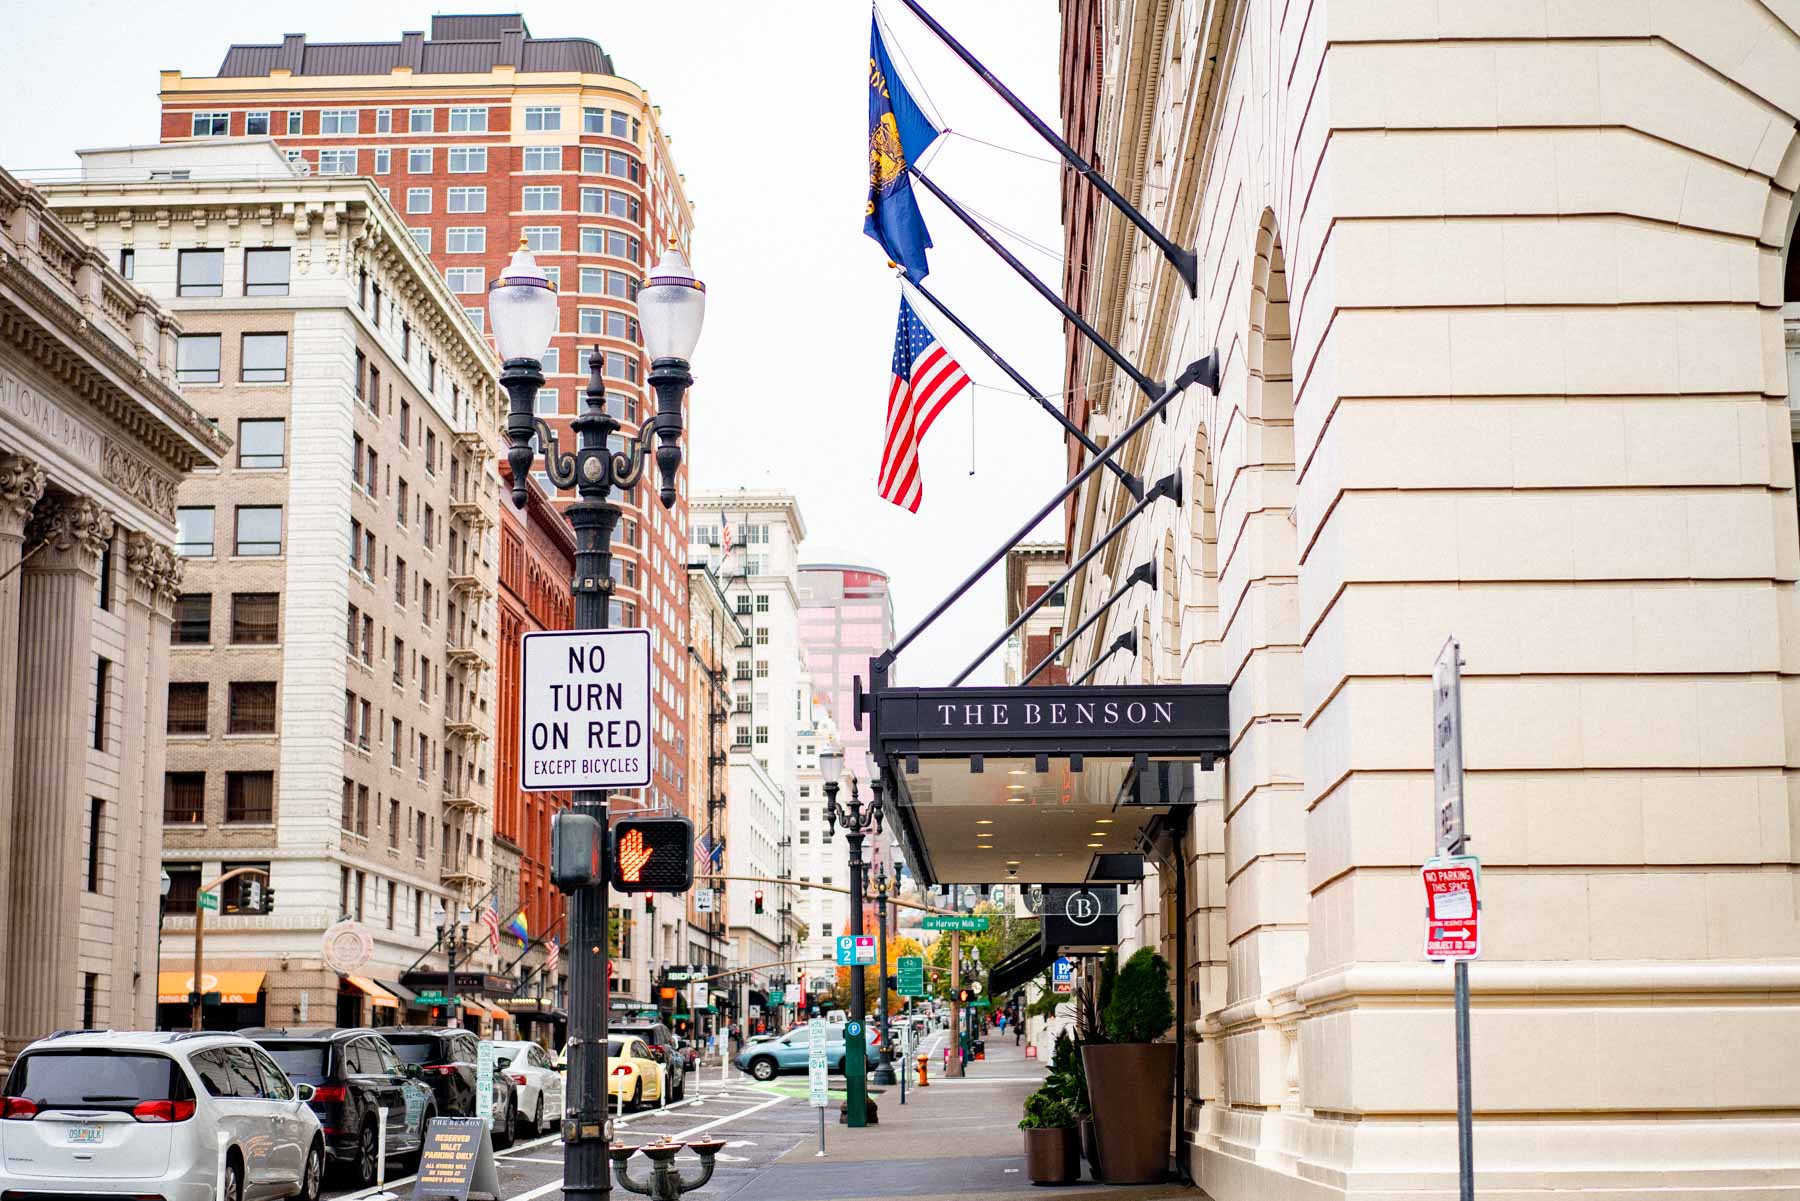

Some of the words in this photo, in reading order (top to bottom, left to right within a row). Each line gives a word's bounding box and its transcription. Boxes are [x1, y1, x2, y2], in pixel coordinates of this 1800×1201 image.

[64, 417, 95, 463] BANK
[568, 645, 605, 674] NO
[549, 683, 622, 712] TURN
[938, 703, 1009, 725] THE
[1023, 702, 1174, 725] BENSON
[532, 722, 569, 750] ON
[588, 720, 641, 749] RED
[534, 759, 576, 775] EXCEPT
[582, 758, 639, 774] BICYCLES
[1426, 872, 1437, 882] NO
[1438, 871, 1471, 881] PARKING
[1431, 883, 1447, 892] THIS
[1448, 881, 1470, 892] SPACE
[1075, 899, 1092, 918] B
[936, 920, 959, 929] Harvey
[843, 950, 851, 962] 2
[435, 1134, 471, 1142] RESERVED
[440, 1143, 462, 1151] VALET
[424, 1151, 455, 1159] PARKING
[455, 1152, 474, 1160] ONLY
